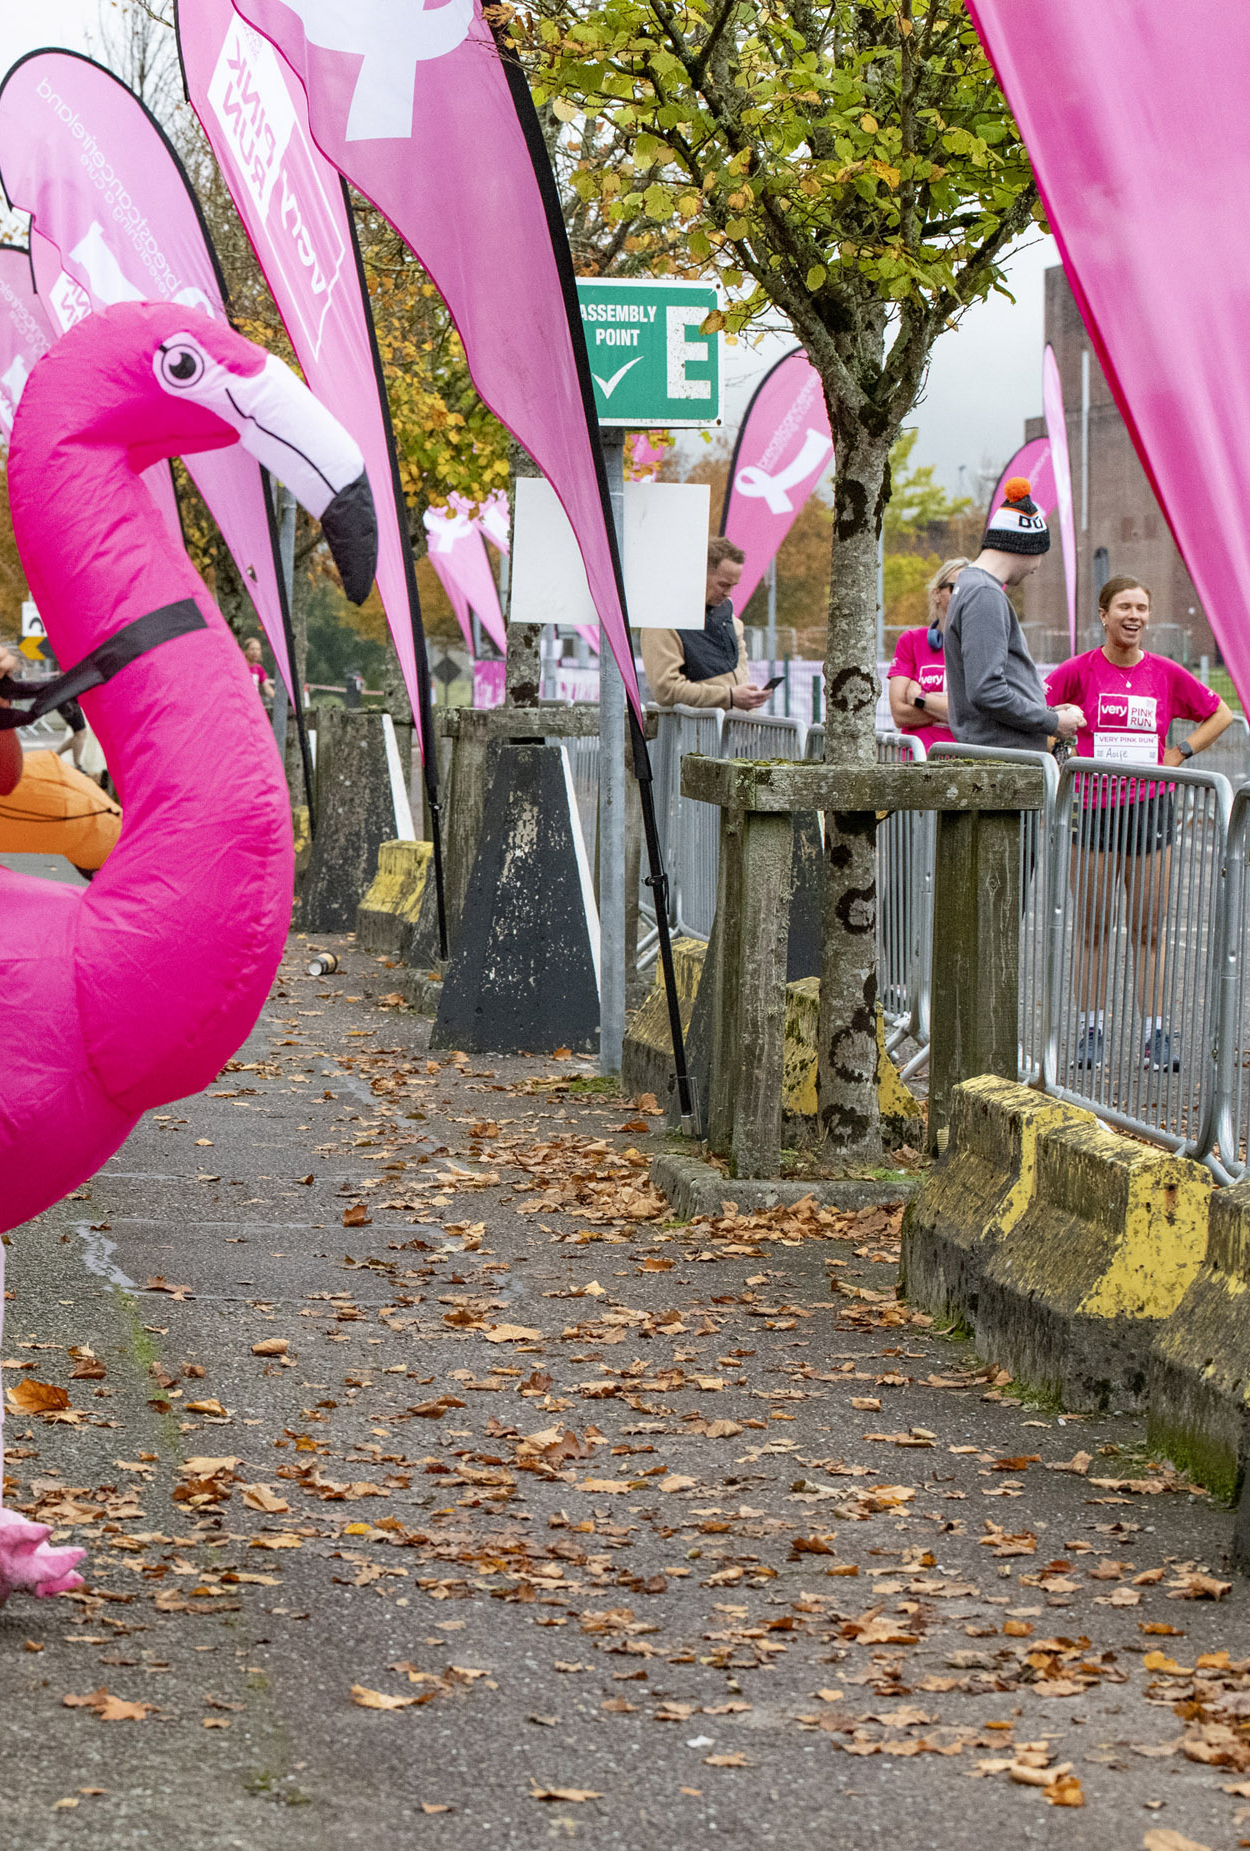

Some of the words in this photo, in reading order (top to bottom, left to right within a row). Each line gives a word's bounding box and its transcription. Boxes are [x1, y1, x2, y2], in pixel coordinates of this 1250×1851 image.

[579, 304, 657, 323] ASSEMBLY
[595, 328, 640, 346] POINT
[666, 305, 711, 399] E
[921, 674, 943, 686] very
[1101, 704, 1128, 717] very
[1131, 707, 1154, 719] PINK
[1130, 716, 1152, 728] RUN
